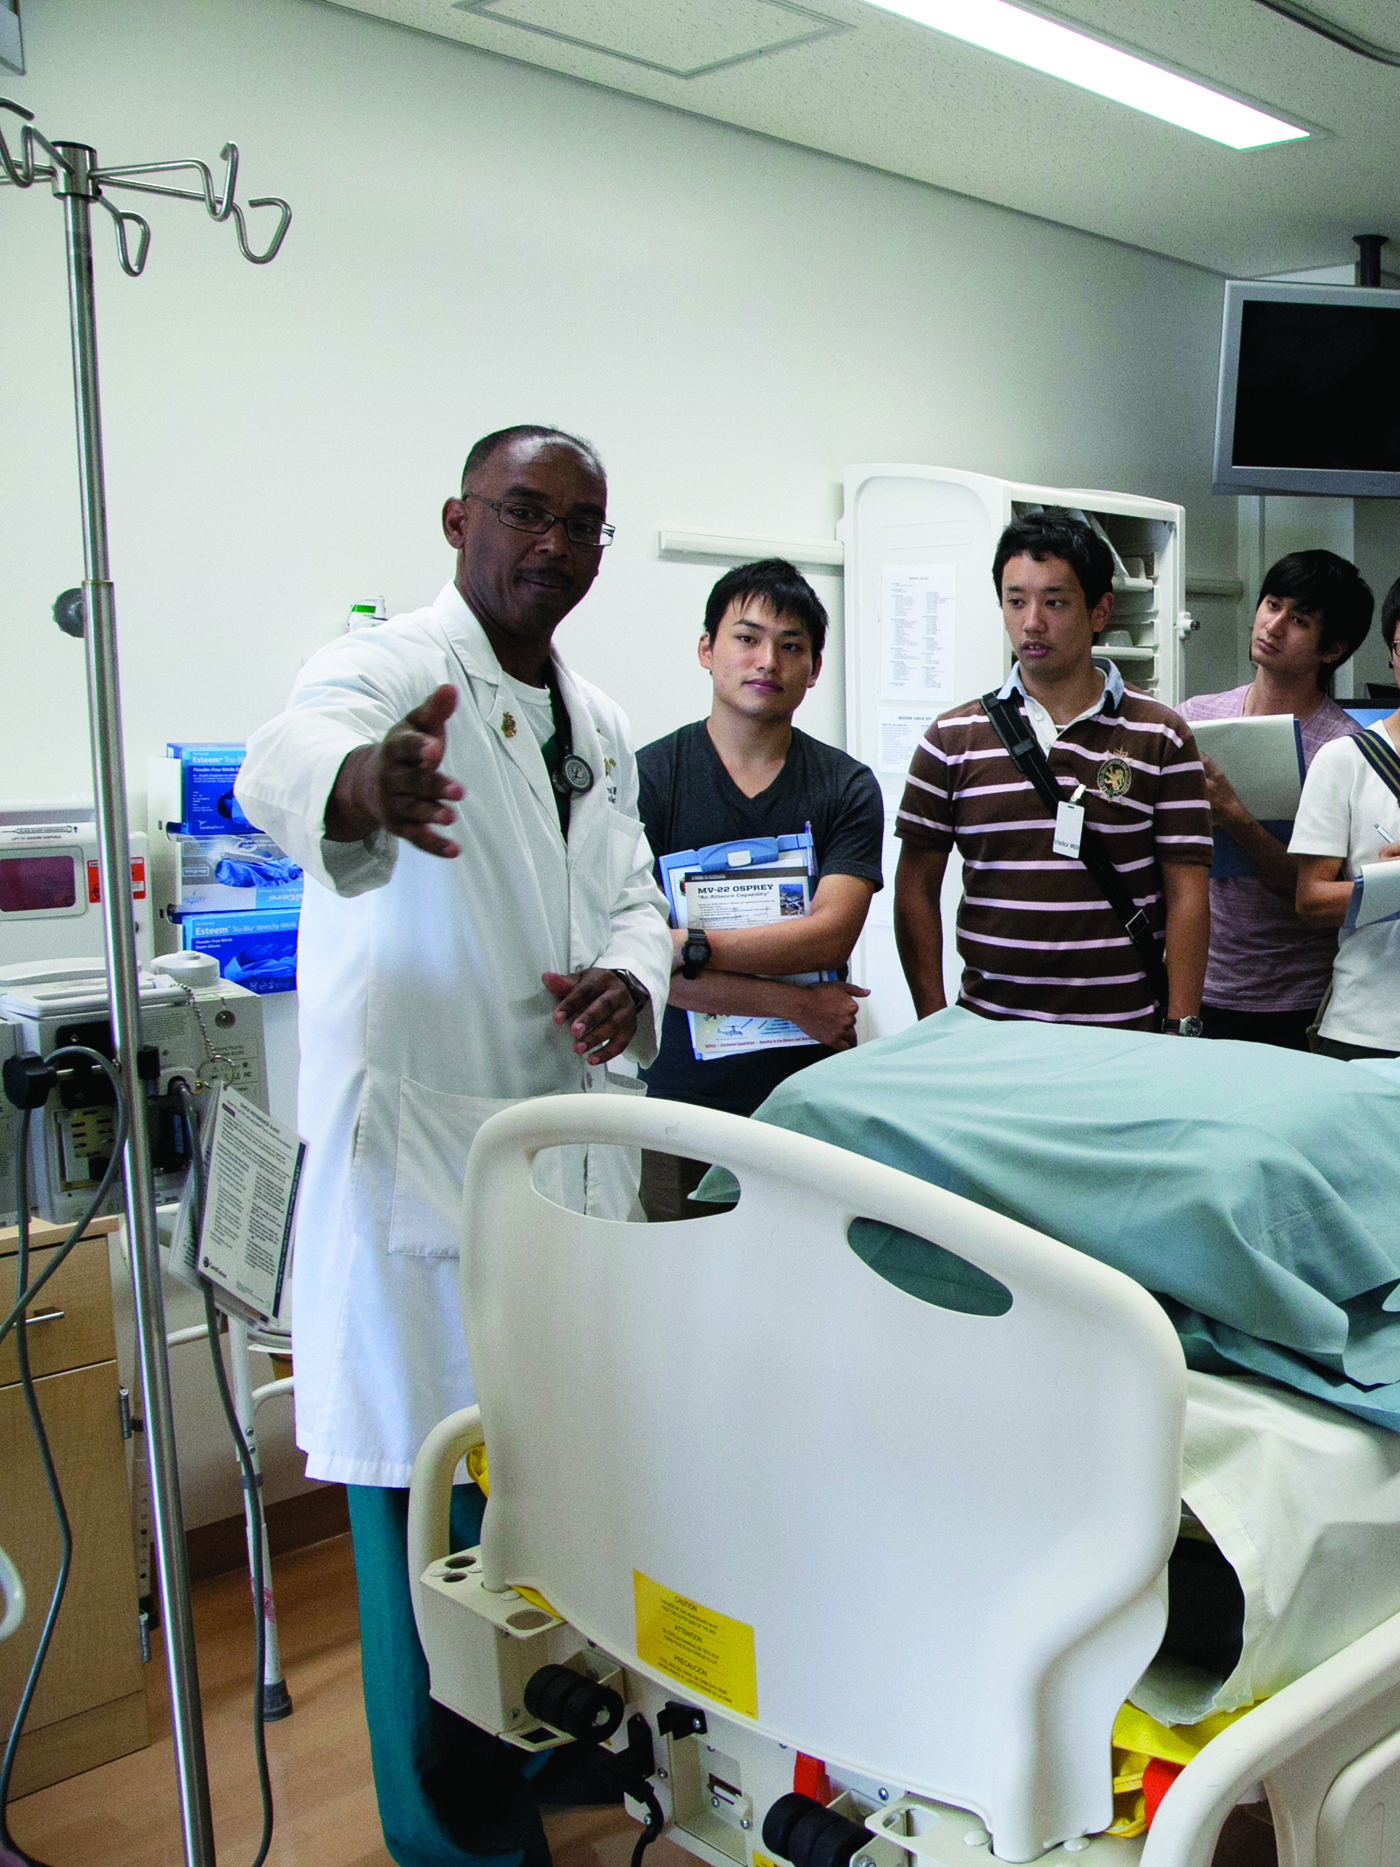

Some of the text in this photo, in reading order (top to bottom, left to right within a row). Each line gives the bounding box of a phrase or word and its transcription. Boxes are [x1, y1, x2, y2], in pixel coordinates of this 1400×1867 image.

[698, 884, 774, 894] MV-22 OSPREY
[195, 927, 228, 936] Esteem
[256, 923, 280, 932] Stretchy
[675, 1596, 698, 1612] CAUTION
[674, 1625, 703, 1644] ATTENTION
